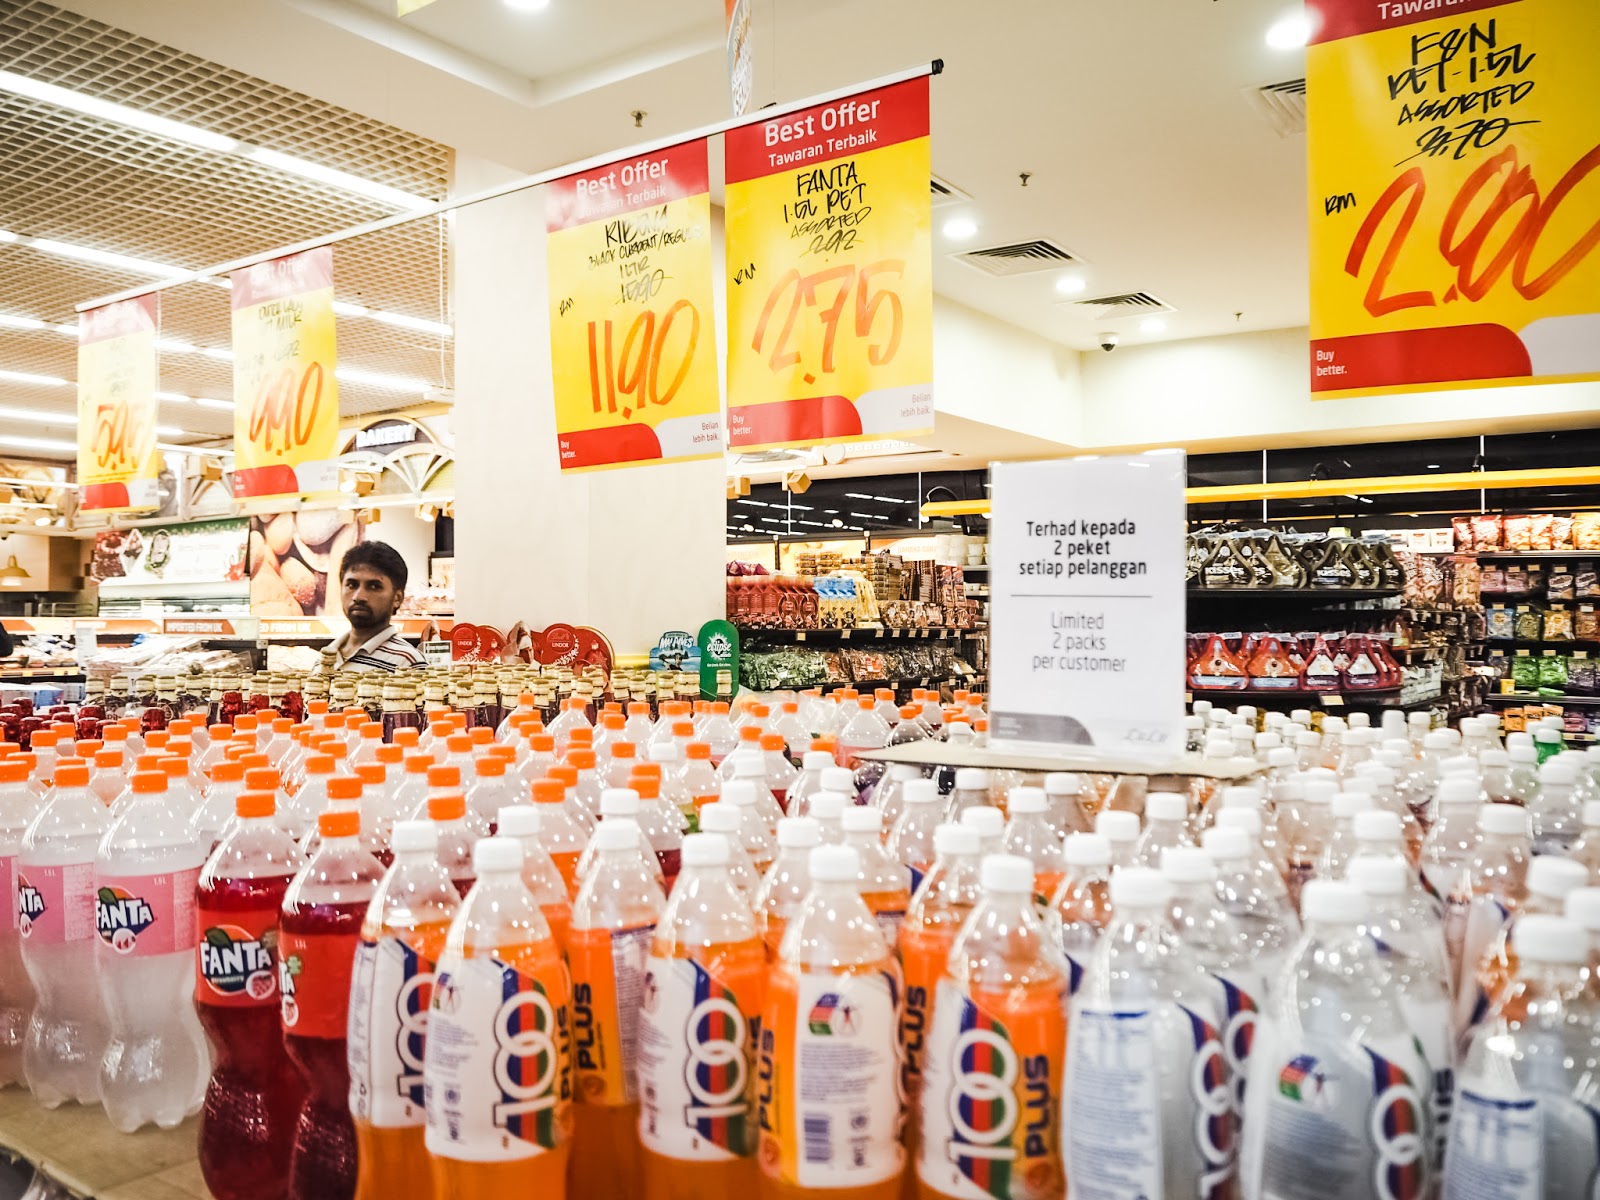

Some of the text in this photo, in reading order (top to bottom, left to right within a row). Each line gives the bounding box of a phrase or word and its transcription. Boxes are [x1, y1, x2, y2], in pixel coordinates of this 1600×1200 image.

[1377, 0, 1470, 19] Tawa
[1398, 80, 1535, 125] ASSORTED
[764, 98, 881, 147] Best Offer
[768, 128, 877, 168] Tawaran Terbaik
[576, 157, 668, 200] Best Offer
[796, 161, 858, 197] FANTA
[626, 187, 666, 208] Terbaik
[827, 183, 867, 216] PET
[1325, 193, 1356, 216] RM
[791, 206, 872, 239] ASSORTED
[752, 259, 905, 385] 2.75
[588, 299, 699, 420] 11.90
[1316, 350, 1334, 363] Buy
[1316, 364, 1347, 376] better.
[911, 392, 931, 403] Belian
[701, 421, 718, 431] Belian
[732, 415, 744, 426] Buy
[732, 426, 753, 436] better.
[357, 424, 416, 447] BAKERY
[560, 439, 570, 450] Buy
[1026, 519, 1135, 538] Terhad kepada
[1054, 539, 1110, 558] 2 peket
[1019, 559, 1147, 578] setiap pelanggan
[166, 622, 195, 633] IMPORTED
[196, 622, 212, 632] FROM
[1051, 612, 1104, 629] Limited
[1053, 632, 1106, 654] 2 packs
[1033, 655, 1126, 672] per customer
[19, 887, 44, 912] NTA
[95, 899, 153, 929] FANTA
[200, 941, 272, 975] FANTA
[575, 983, 598, 1071] PLUS
[493, 990, 558, 1129] 100
[685, 997, 749, 1129] 100
[949, 1028, 1018, 1166] 100
[1025, 1054, 1049, 1158] PLUS
[1373, 1084, 1428, 1200] 00
